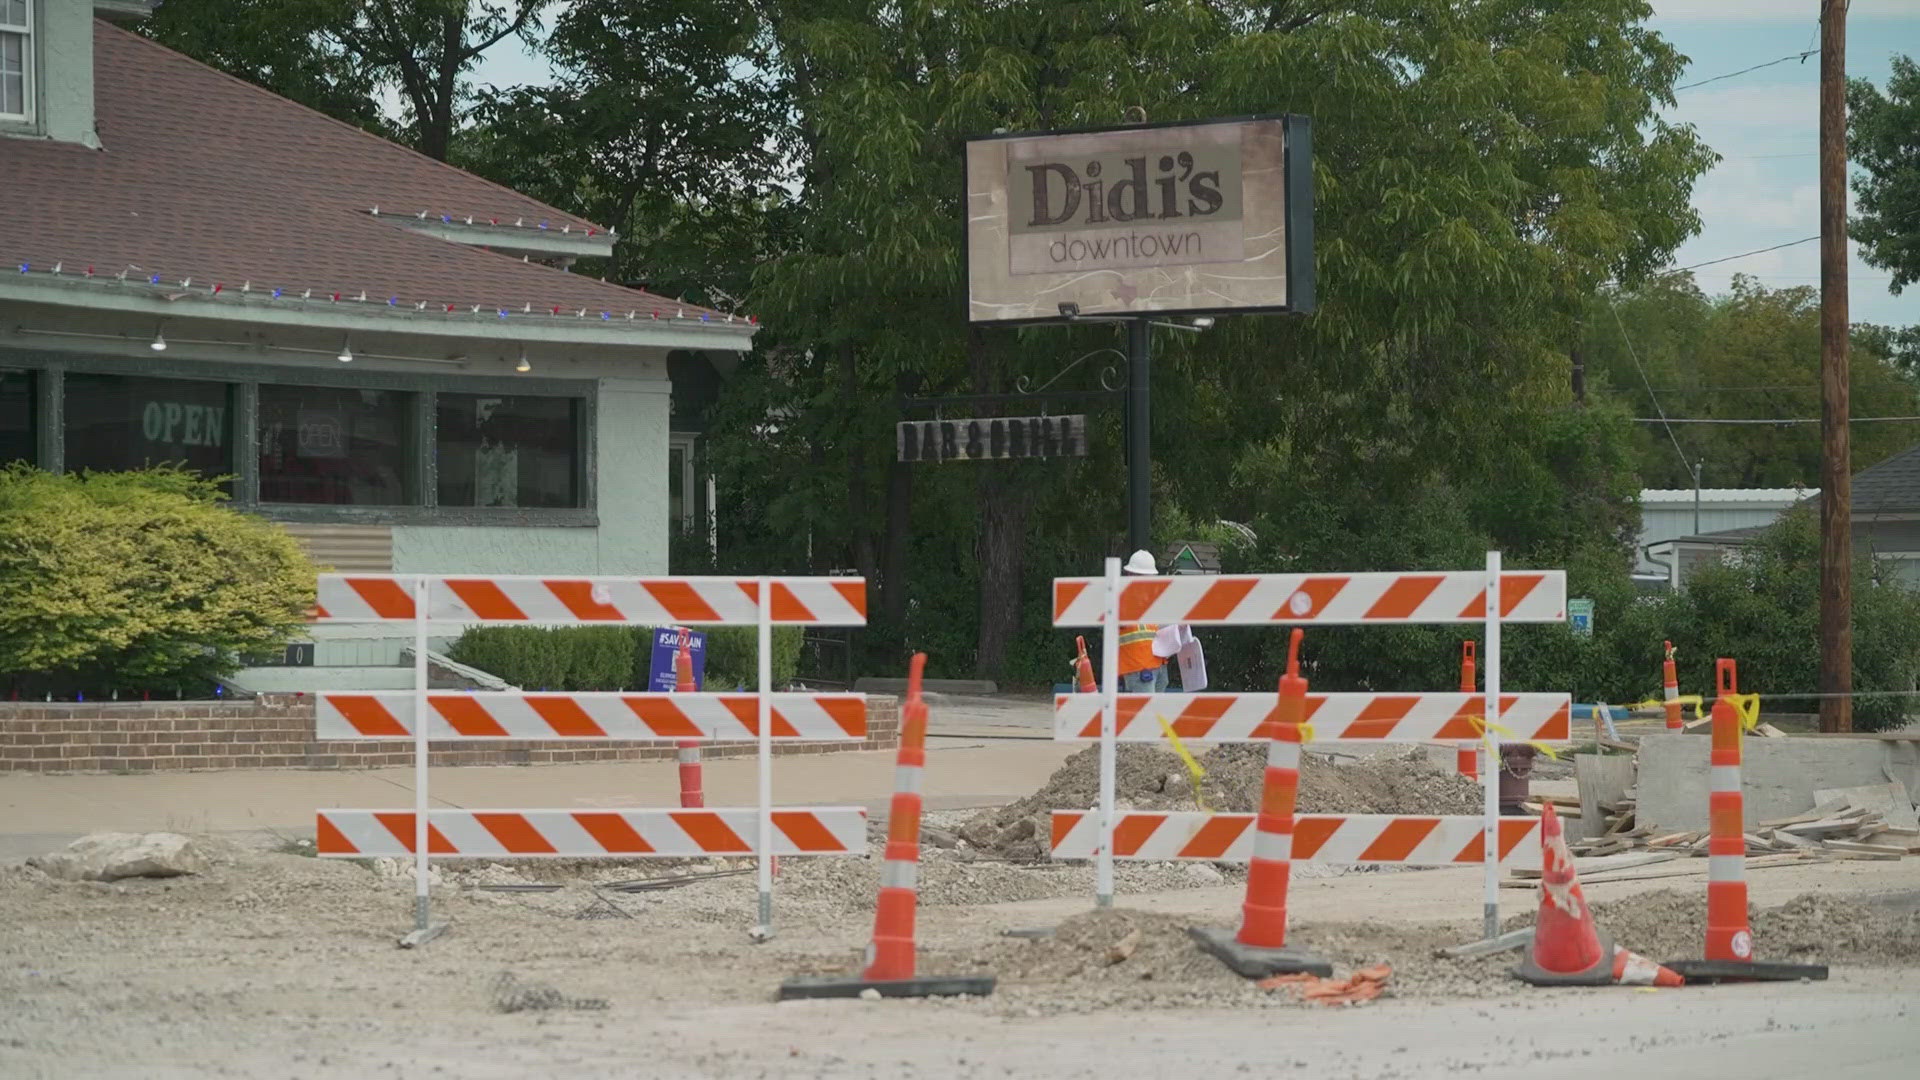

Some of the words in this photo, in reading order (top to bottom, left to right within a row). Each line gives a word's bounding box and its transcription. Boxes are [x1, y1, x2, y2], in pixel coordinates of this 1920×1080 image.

[1025, 151, 1223, 226] Didi's
[1050, 231, 1201, 263] downtown
[143, 401, 224, 446] OPEN
[300, 423, 342, 447] OPEN
